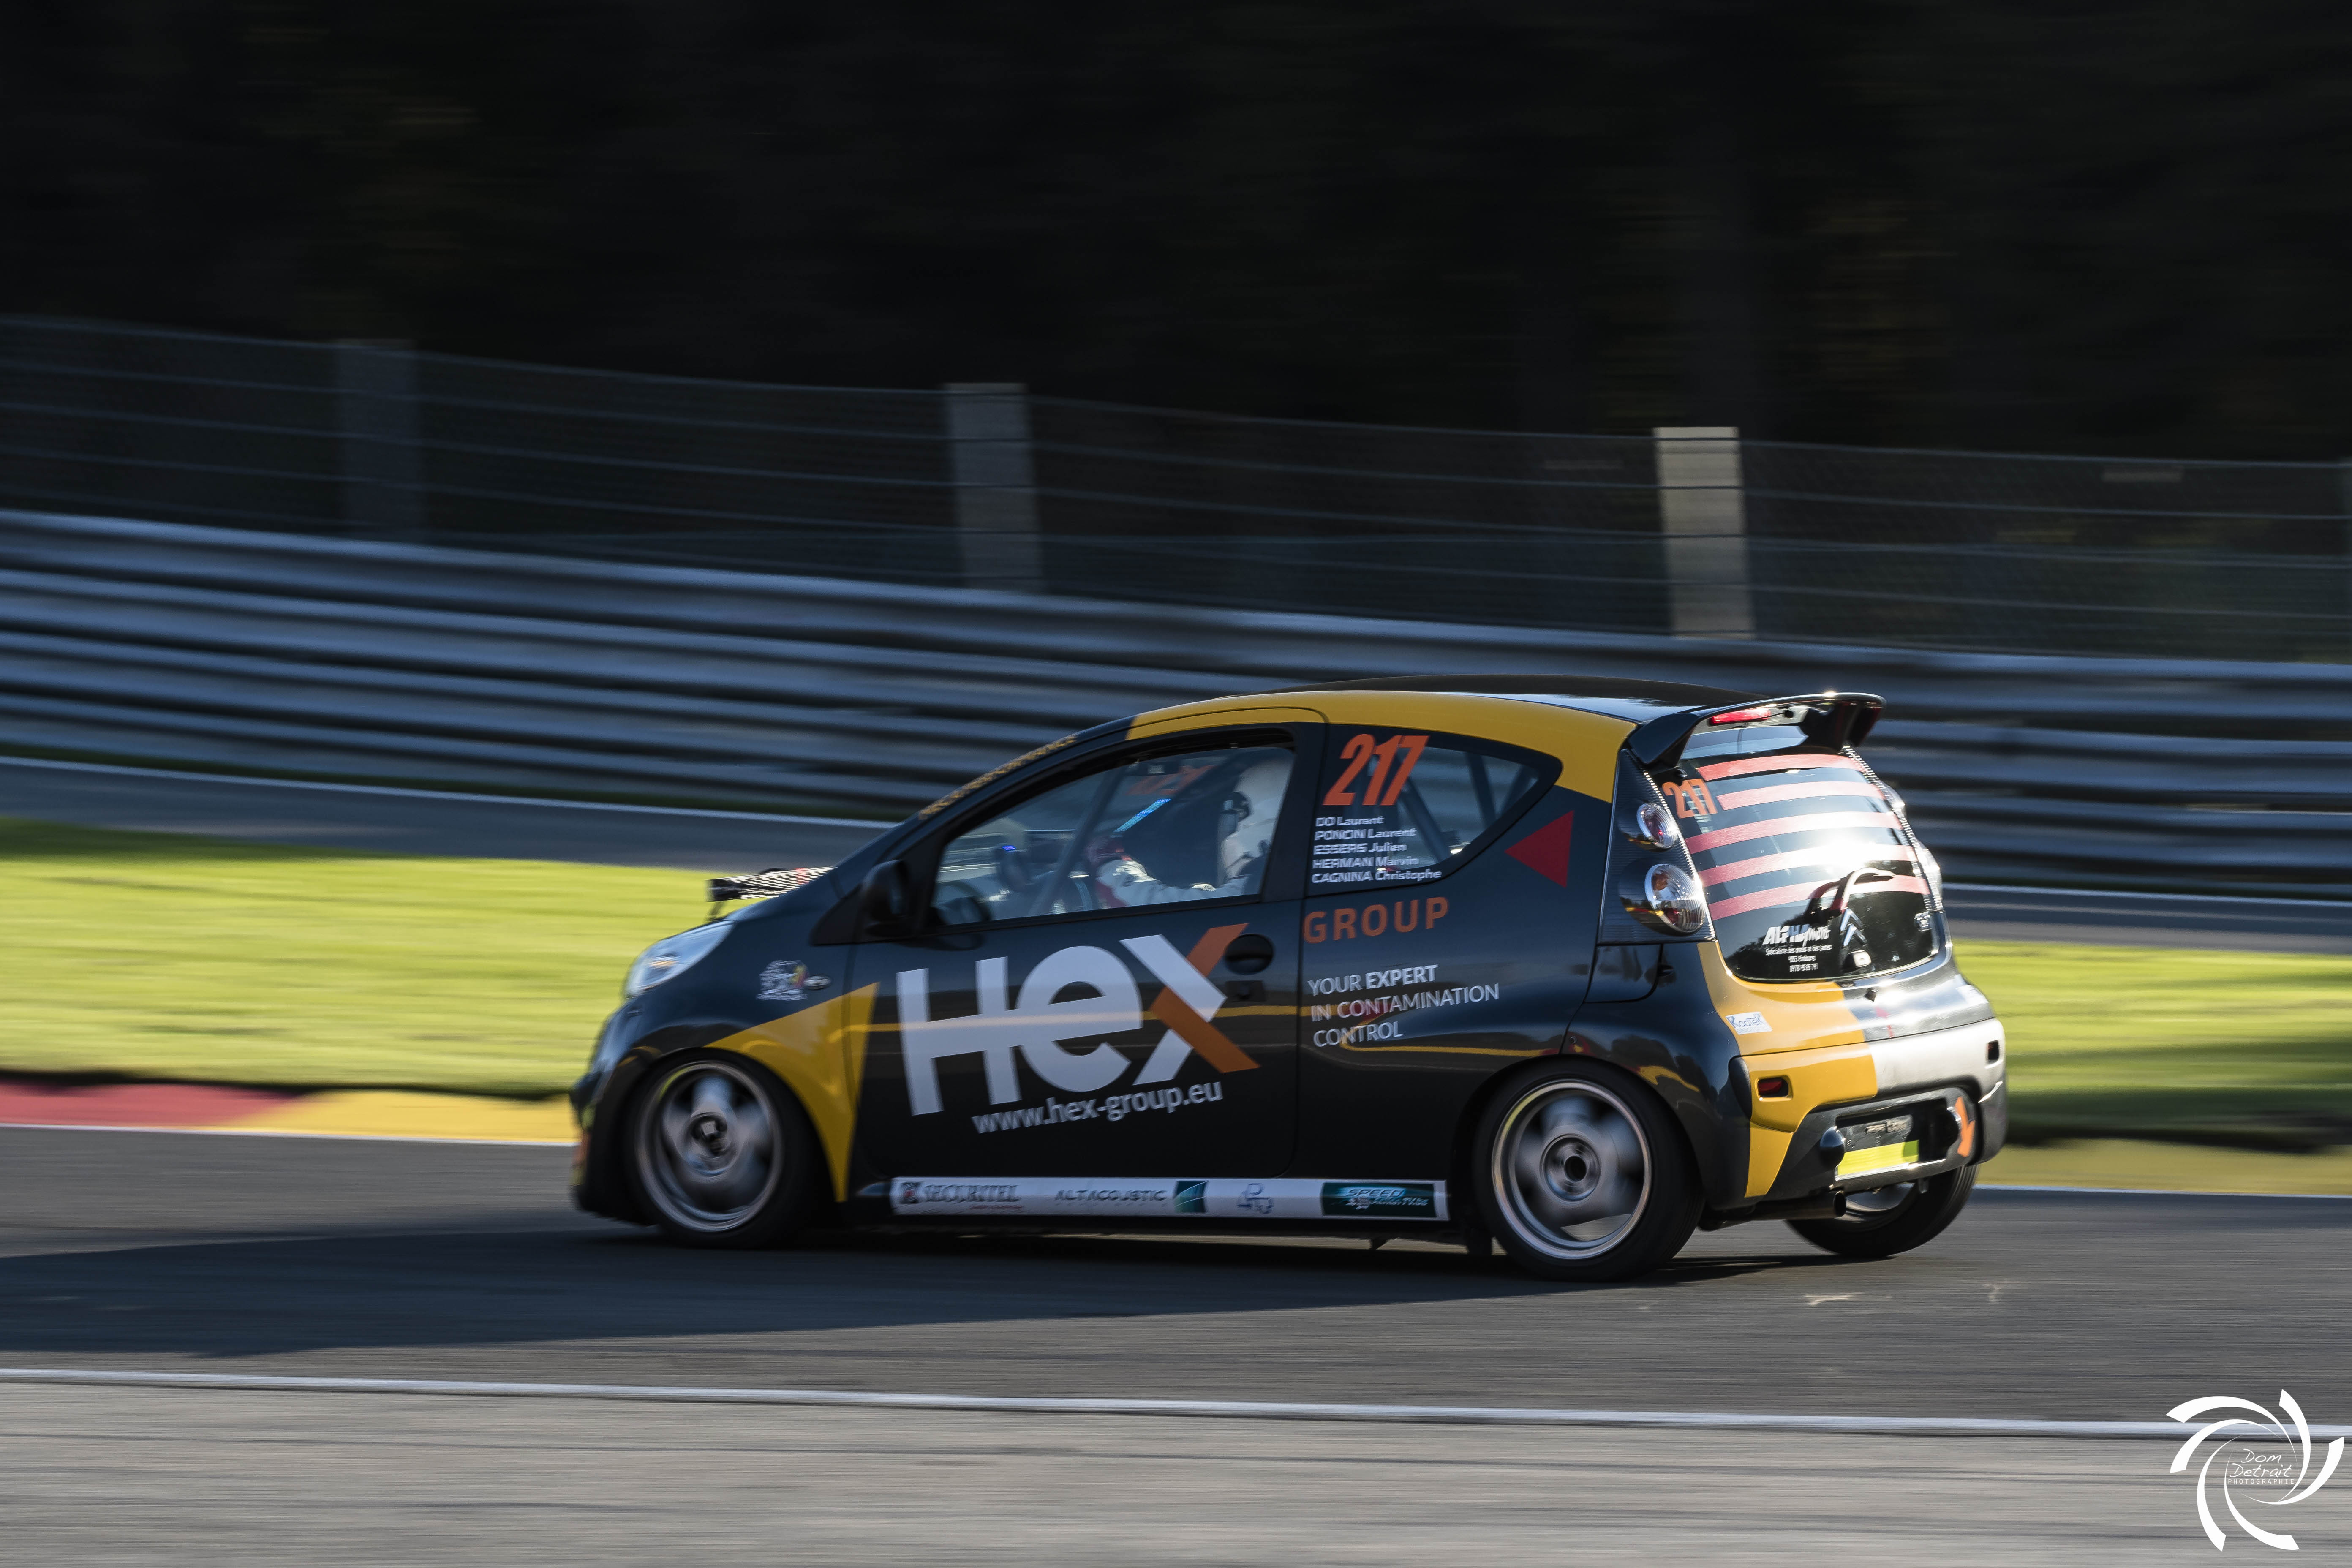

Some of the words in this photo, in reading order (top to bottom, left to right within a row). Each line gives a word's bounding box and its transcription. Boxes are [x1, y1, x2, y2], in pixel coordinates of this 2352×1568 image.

[1323, 734, 1430, 806] 217
[1662, 779, 1718, 819] 217
[1314, 829, 1367, 841] PONCIN
[1367, 828, 1417, 838] Laurent
[1337, 816, 1384, 826] Laurent
[1312, 857, 1372, 869] HERMAN
[1376, 855, 1419, 867] Marvin
[1313, 843, 1367, 855] ESSERS
[1368, 842, 1407, 852] Julien
[1311, 871, 1373, 883] CAGNINA
[1375, 868, 1442, 882] Christophe
[1302, 896, 1449, 943] GROUP
[1308, 974, 1362, 996] YOUR
[1365, 964, 1438, 989] EXPERT
[1311, 1004, 1332, 1021] IN
[1337, 983, 1499, 1018] CONTAMINATION
[1313, 1021, 1403, 1048] CONTROL
[971, 1082, 1223, 1134] www.hex-group.eu
[1345, 1188, 1402, 1197] SPEED
